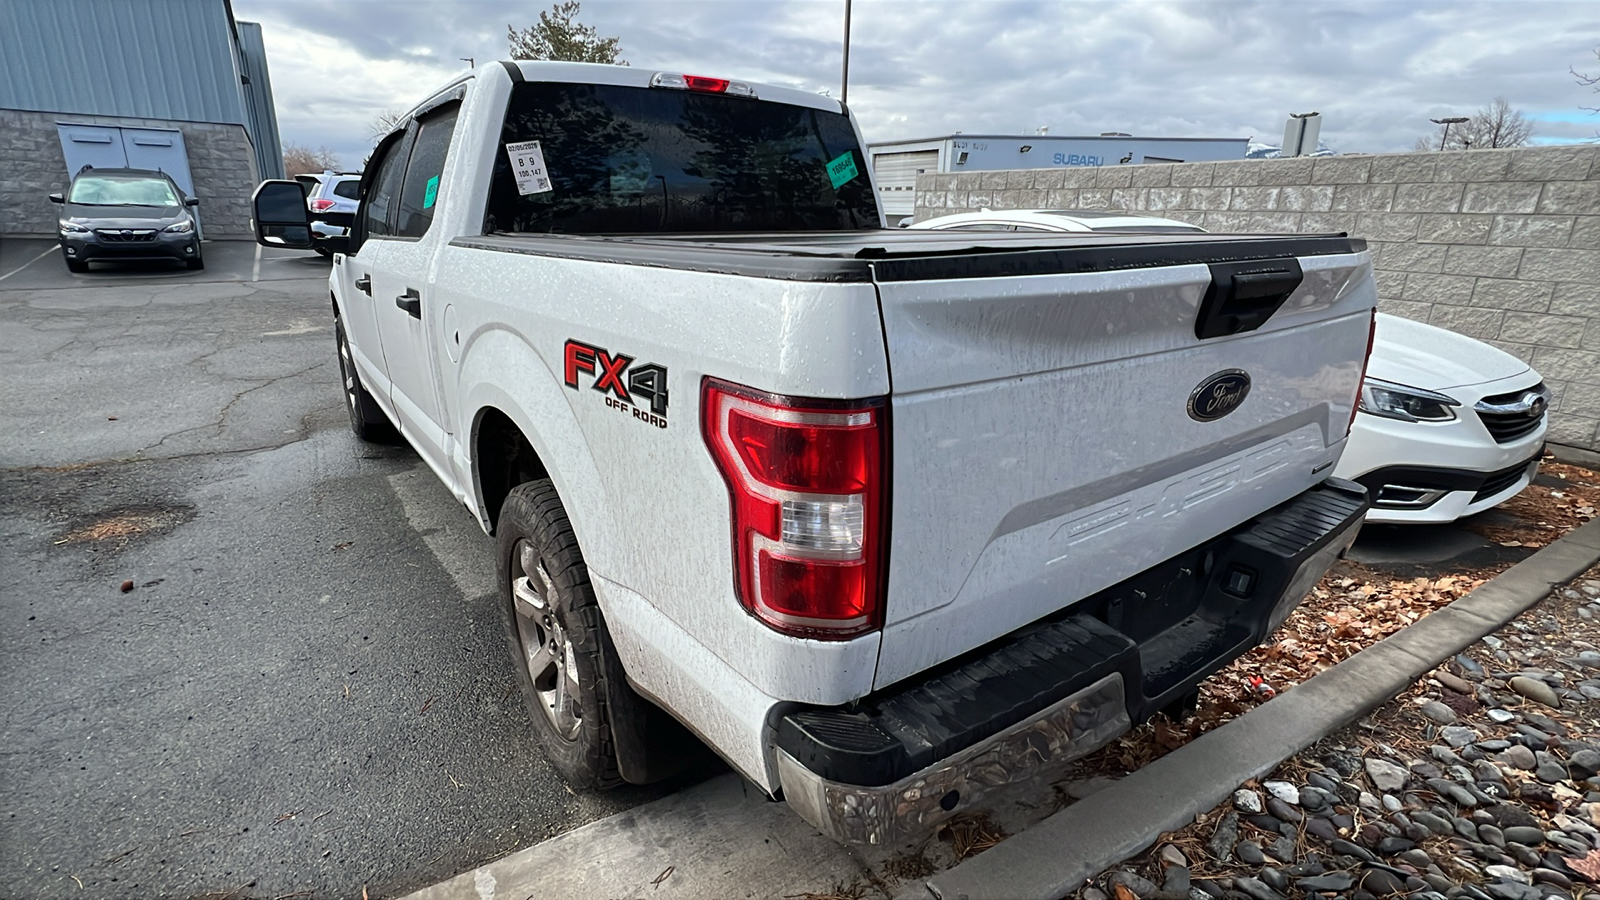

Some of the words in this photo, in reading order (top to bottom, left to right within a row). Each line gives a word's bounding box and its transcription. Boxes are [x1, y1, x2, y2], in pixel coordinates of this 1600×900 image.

[518, 158, 525, 167] B
[529, 156, 535, 166] 9
[1053, 152, 1104, 167] SUBARU
[564, 337, 669, 419] FX4
[605, 396, 629, 413] OFF
[632, 407, 668, 429] ROAD
[1206, 381, 1243, 413] Ford
